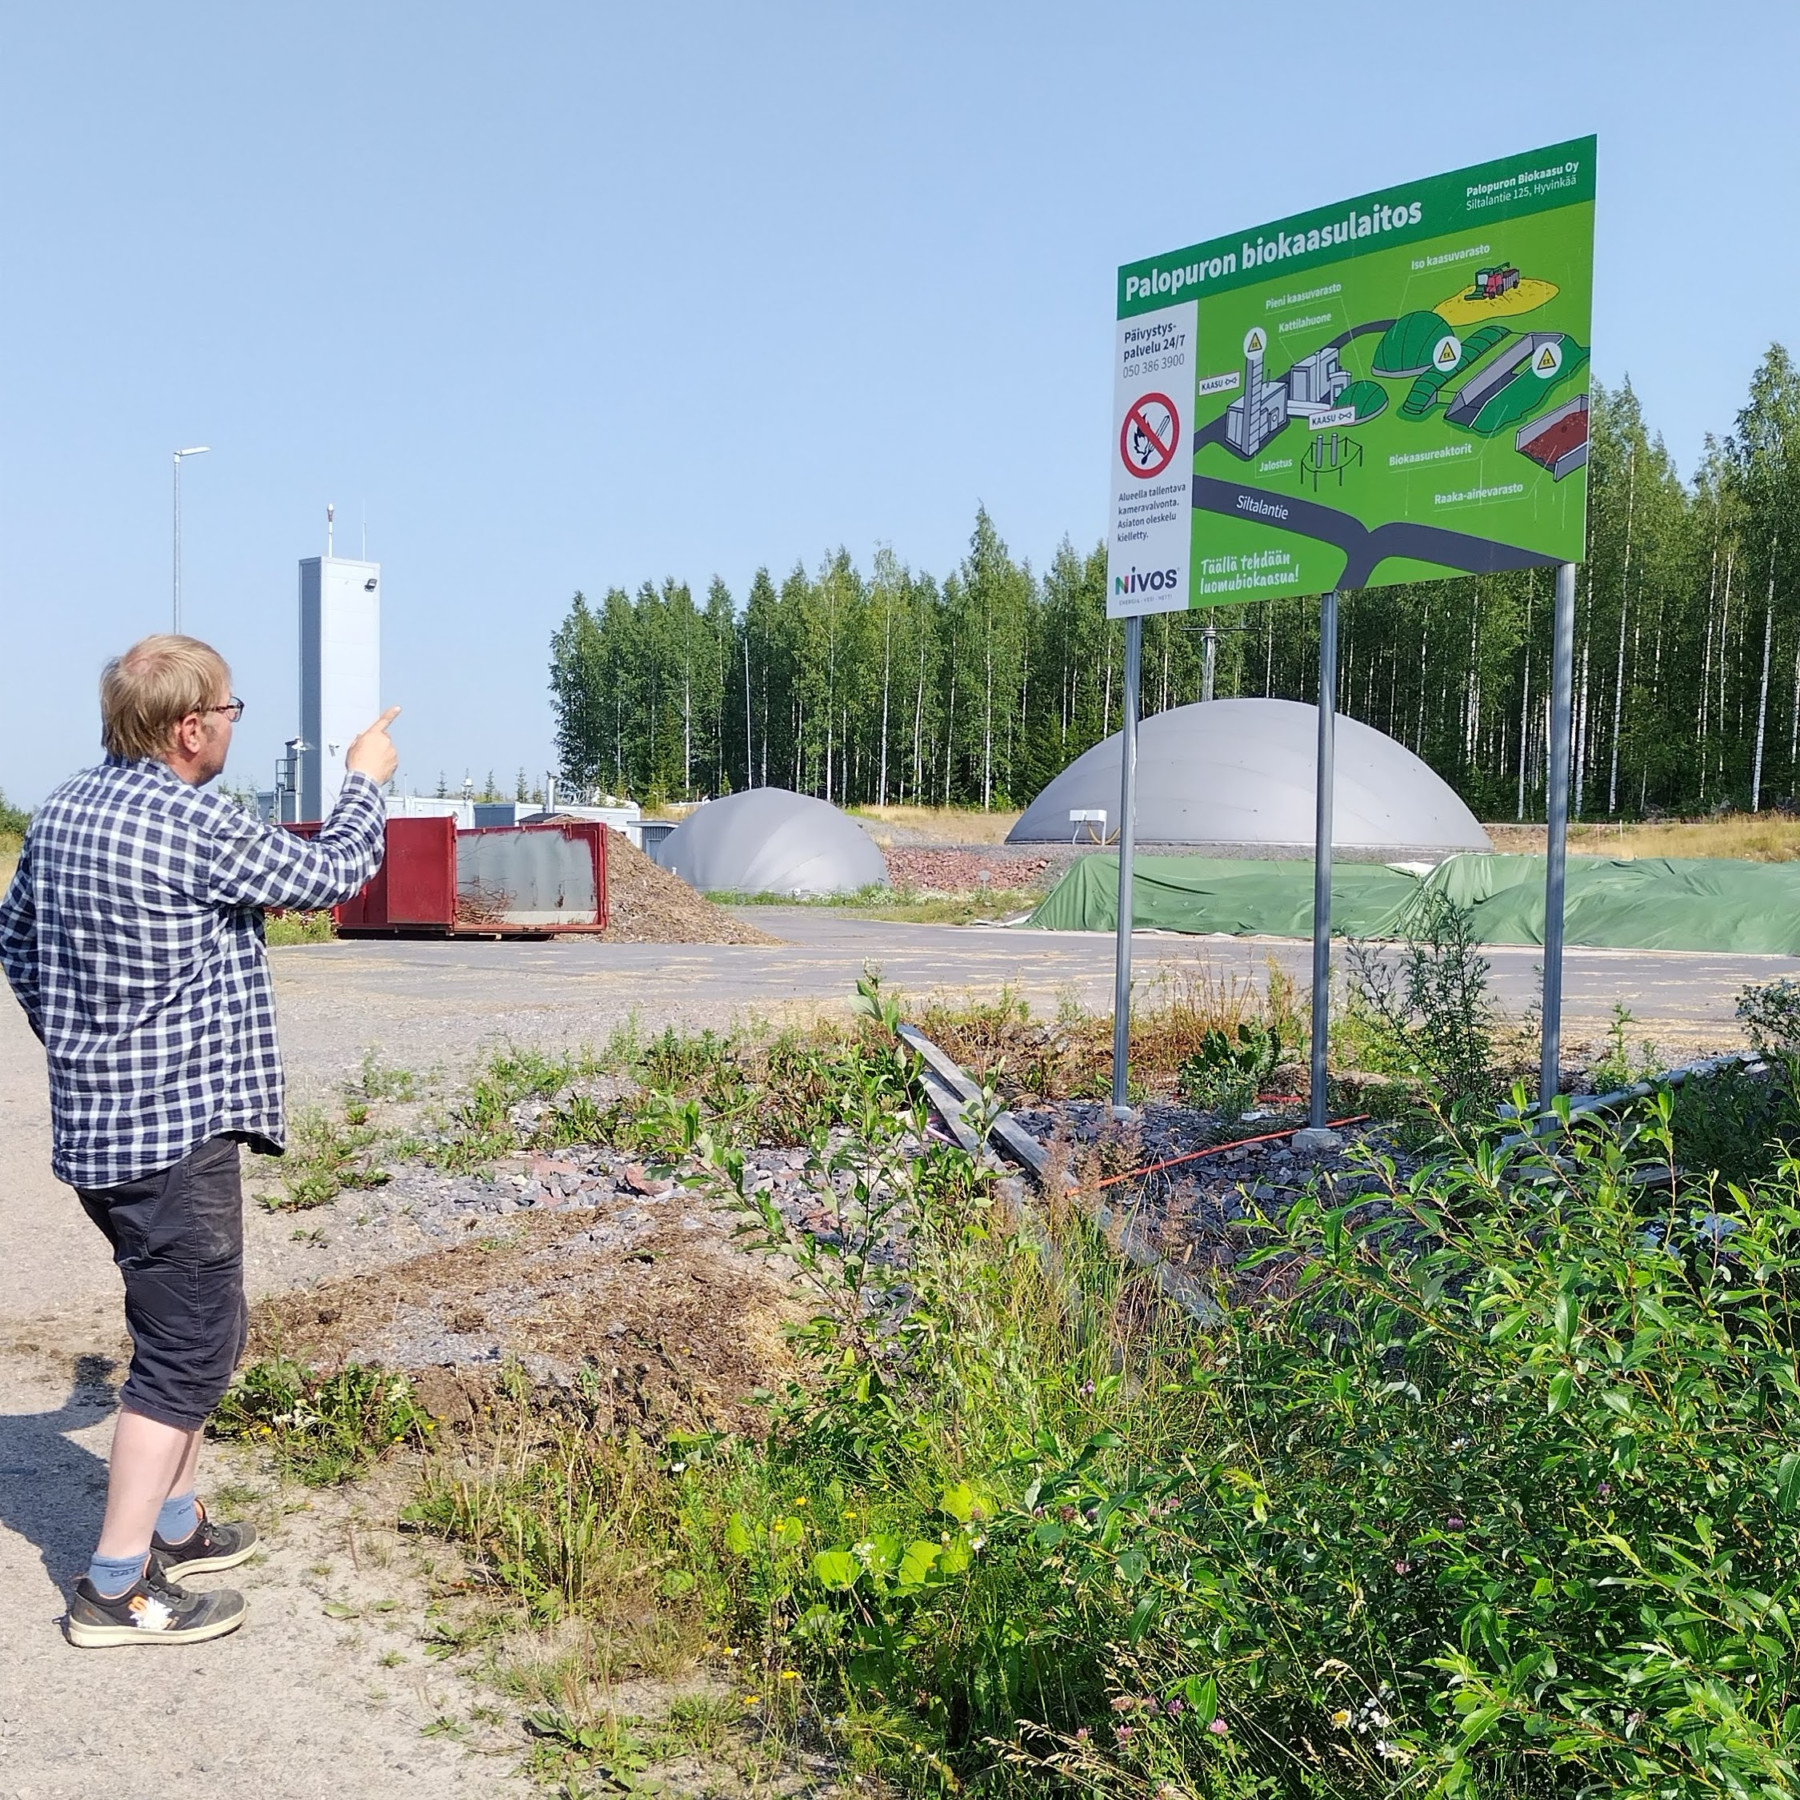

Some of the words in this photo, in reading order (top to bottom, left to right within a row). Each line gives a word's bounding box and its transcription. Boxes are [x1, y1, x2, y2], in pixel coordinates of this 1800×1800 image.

[1466, 178, 1516, 197] Palopuron
[1518, 165, 1563, 184] Biokaasu
[1565, 162, 1579, 174] Oy
[1466, 191, 1511, 211] Siltalantie
[1513, 187, 1532, 200] 125,
[1534, 175, 1577, 195] Hyvinkää
[1126, 252, 1236, 302] Palopuron
[1242, 201, 1422, 270] biokaasulaitos
[1411, 259, 1425, 270] Iso
[1427, 244, 1491, 267] kaasuvarasto
[1266, 295, 1286, 310] Pieni
[1287, 283, 1342, 305] kaasuvarasto
[1124, 322, 1177, 344] Päivystys-
[1279, 313, 1332, 333] Kattilahuone
[1123, 341, 1161, 363] palvelu
[1163, 334, 1186, 350] 24/7
[1122, 363, 1140, 378] 050
[1142, 359, 1160, 374] 386
[1161, 353, 1185, 370] 3900
[1201, 380, 1223, 391] KAASU
[1312, 415, 1336, 426] KAASU
[1259, 458, 1293, 473] Jalostus
[1389, 443, 1472, 466] Biokaasureaktorit
[1119, 488, 1147, 502] Alueella
[1149, 483, 1186, 497] tallentava
[1434, 483, 1524, 504] Raaka-ainevarasto
[1118, 498, 1179, 515] kameravalvonta.
[1236, 495, 1289, 520] Siltalantie
[1117, 517, 1144, 529] Asiaton
[1146, 512, 1177, 525] oleskelu
[1117, 530, 1149, 543] kielletty.
[1201, 556, 1238, 575] Täällä
[1241, 549, 1291, 571] tehdään
[1200, 564, 1300, 595] luomubiokaasua!
